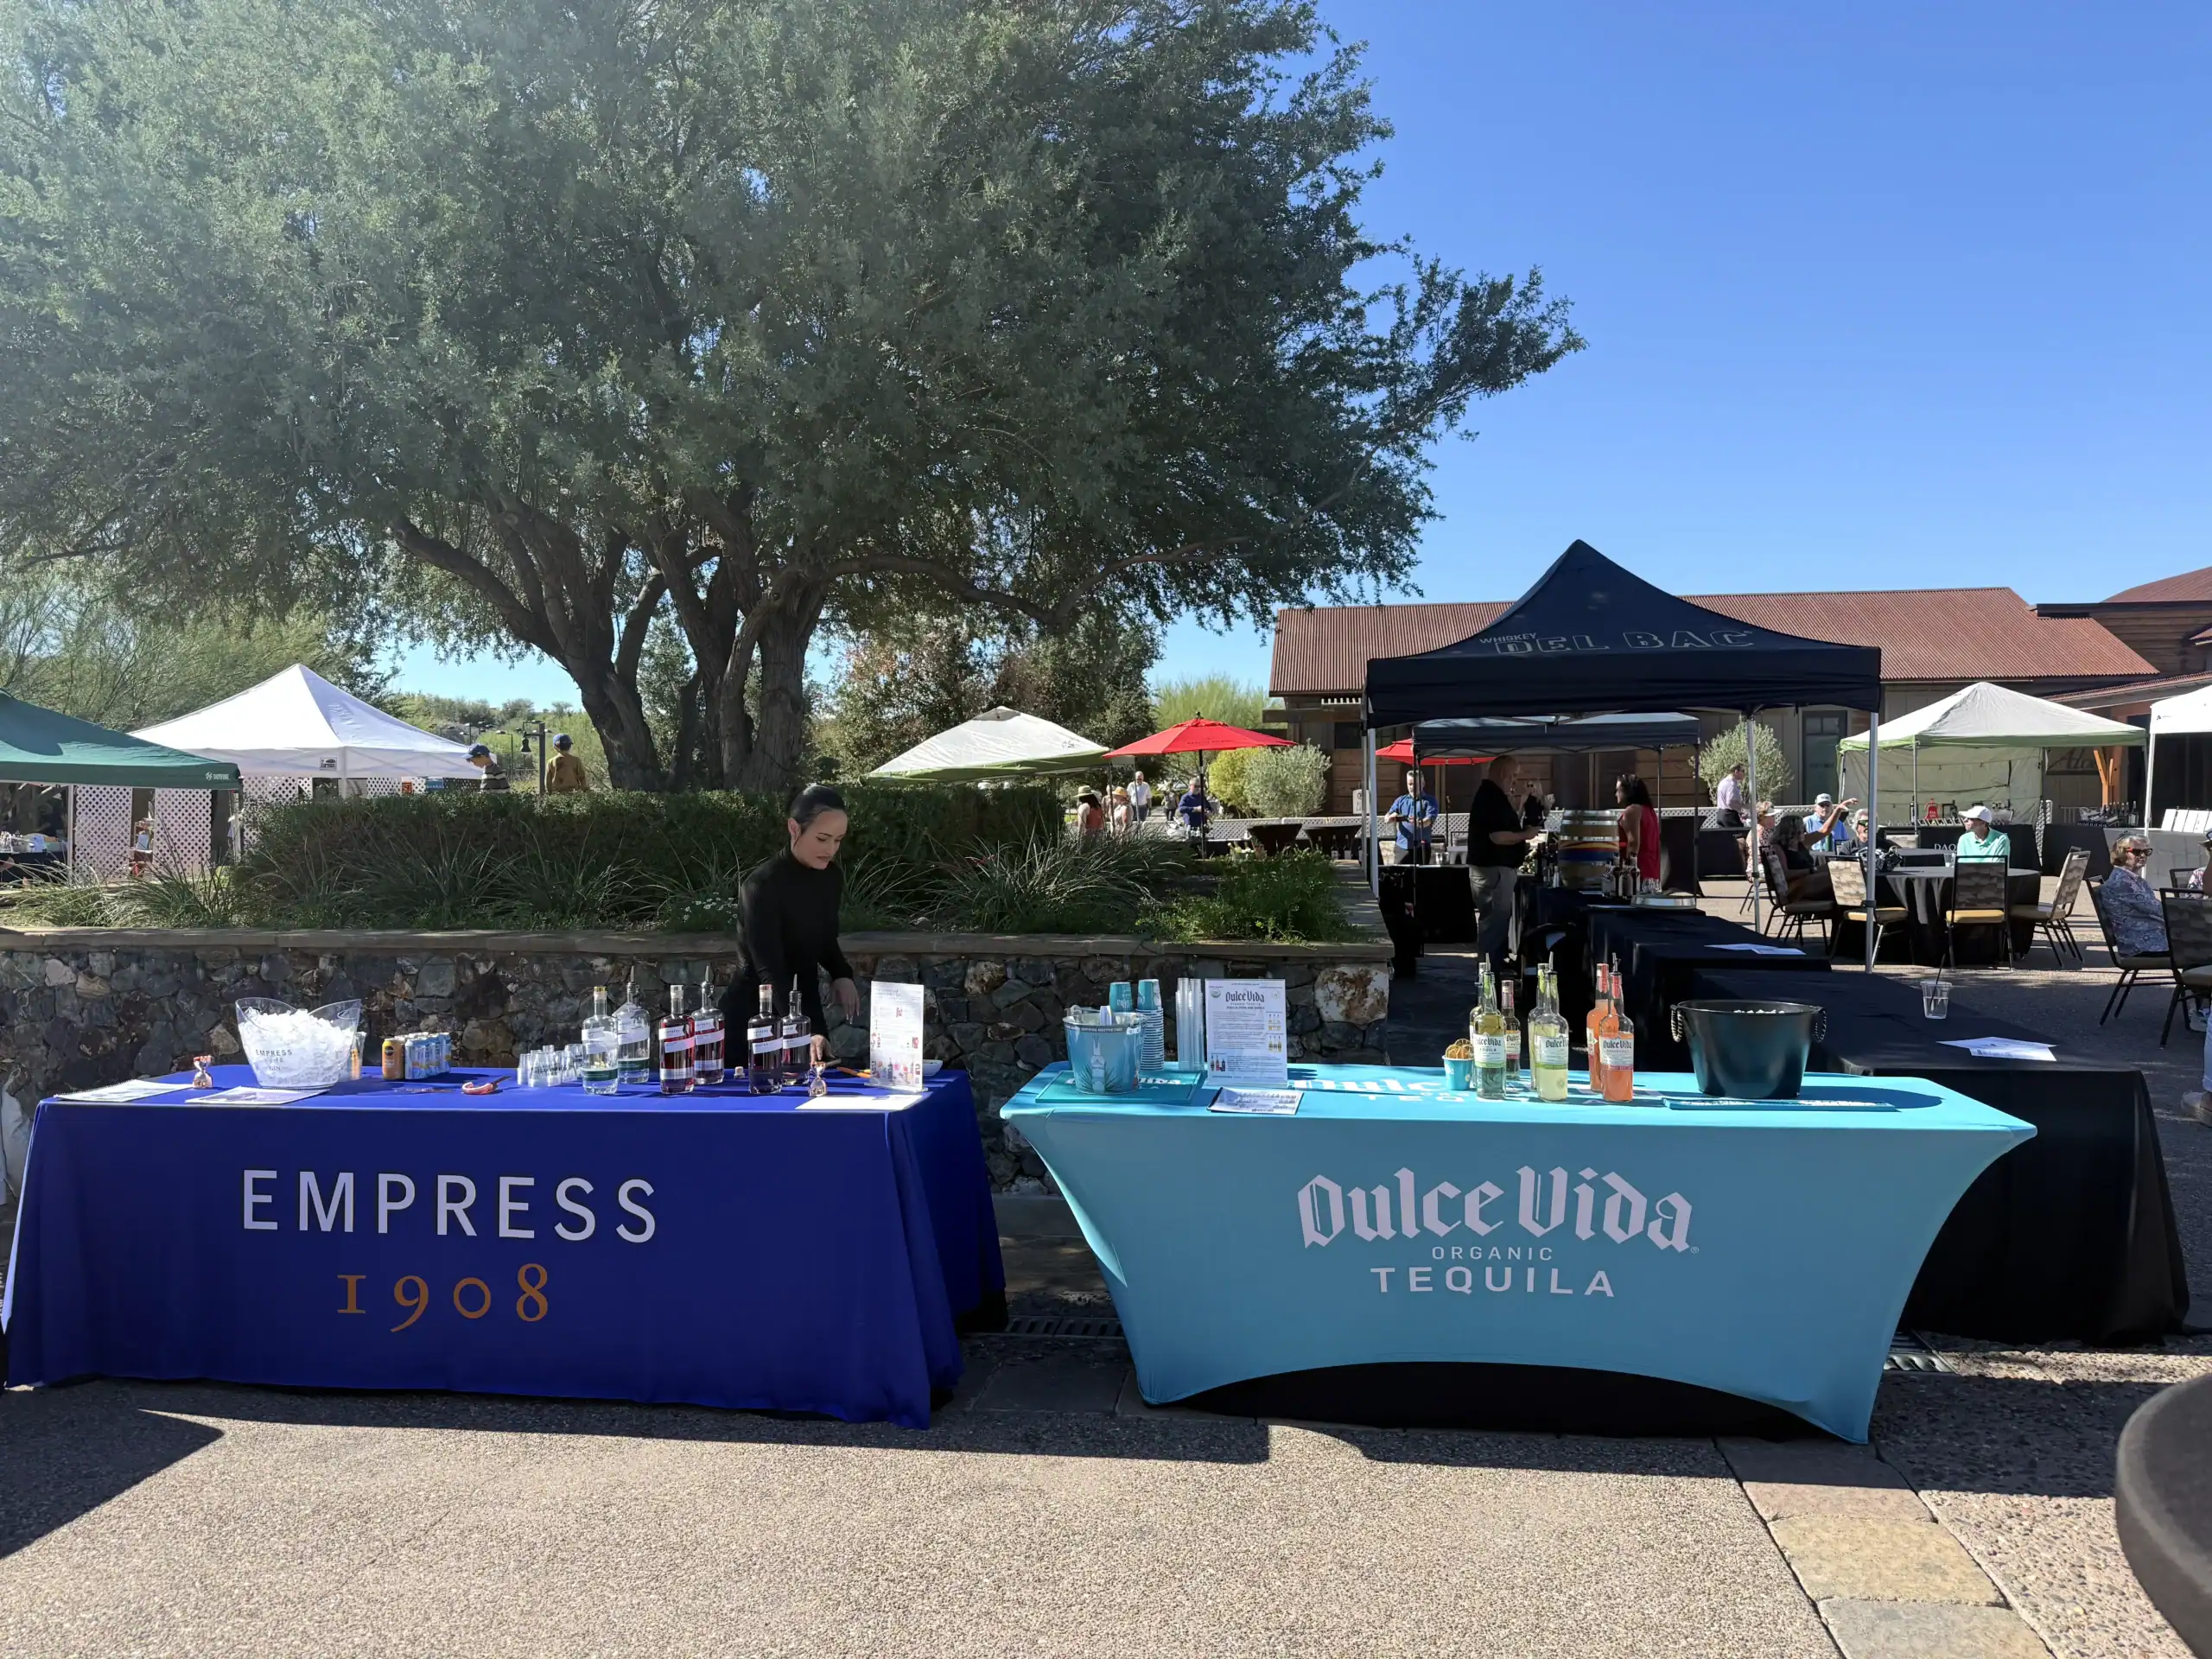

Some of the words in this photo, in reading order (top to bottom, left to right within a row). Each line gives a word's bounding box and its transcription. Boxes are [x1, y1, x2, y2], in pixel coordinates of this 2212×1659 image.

[1479, 632, 1537, 644] WHISKEY
[1495, 635, 1611, 654] DEL
[1623, 631, 1754, 648] BAC
[1225, 990, 1245, 1002] Dulce
[1247, 990, 1265, 1002] Vida
[1488, 1037, 1502, 1046] Vida
[1546, 1039, 1562, 1048] Dulce
[1603, 1039, 1619, 1049] Dulce
[1620, 1039, 1632, 1049] Vida
[1288, 1079, 1441, 1092] Dulc
[244, 1170, 656, 1243] EMPRESS
[1297, 1167, 1504, 1249] Dulce
[1516, 1166, 1692, 1252] Vida
[1432, 1246, 1552, 1262] ORGANIC
[1370, 1266, 1614, 1297] TEQUILA
[337, 1263, 548, 1332] 1908
